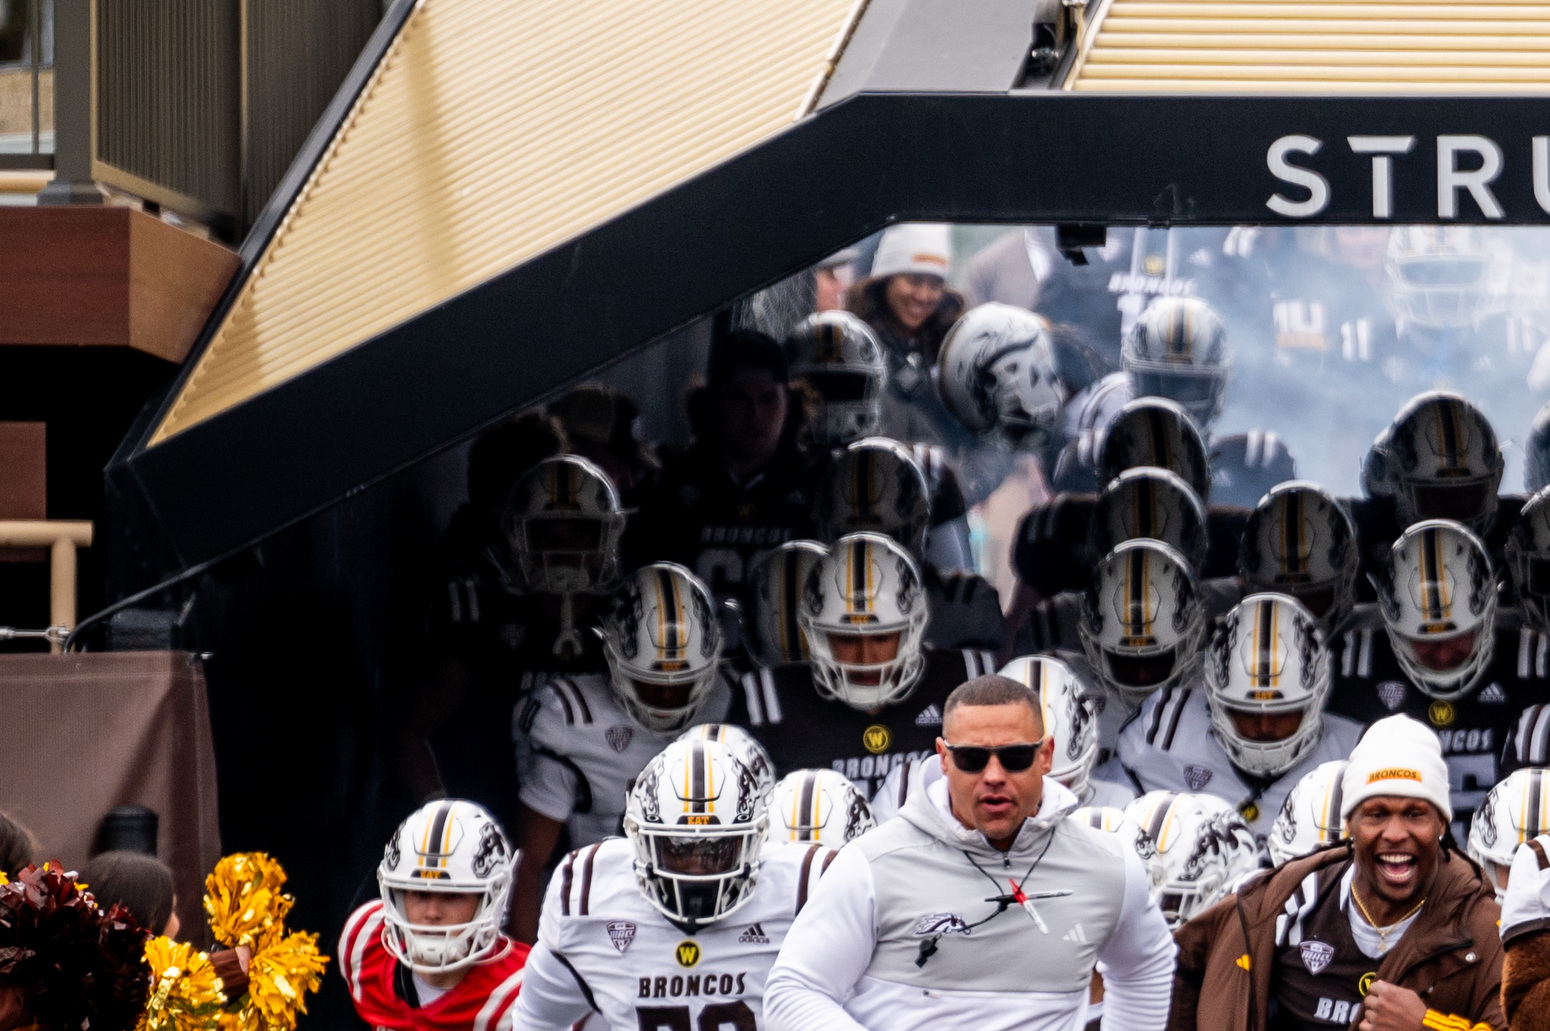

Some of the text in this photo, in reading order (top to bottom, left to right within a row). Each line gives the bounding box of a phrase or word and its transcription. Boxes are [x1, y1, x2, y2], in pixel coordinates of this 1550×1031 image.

[1370, 769, 1417, 780] BRONCOS
[687, 815, 711, 825] EAT
[738, 933, 771, 945] adidas
[677, 944, 699, 966] W
[638, 972, 747, 999] BRONCOS
